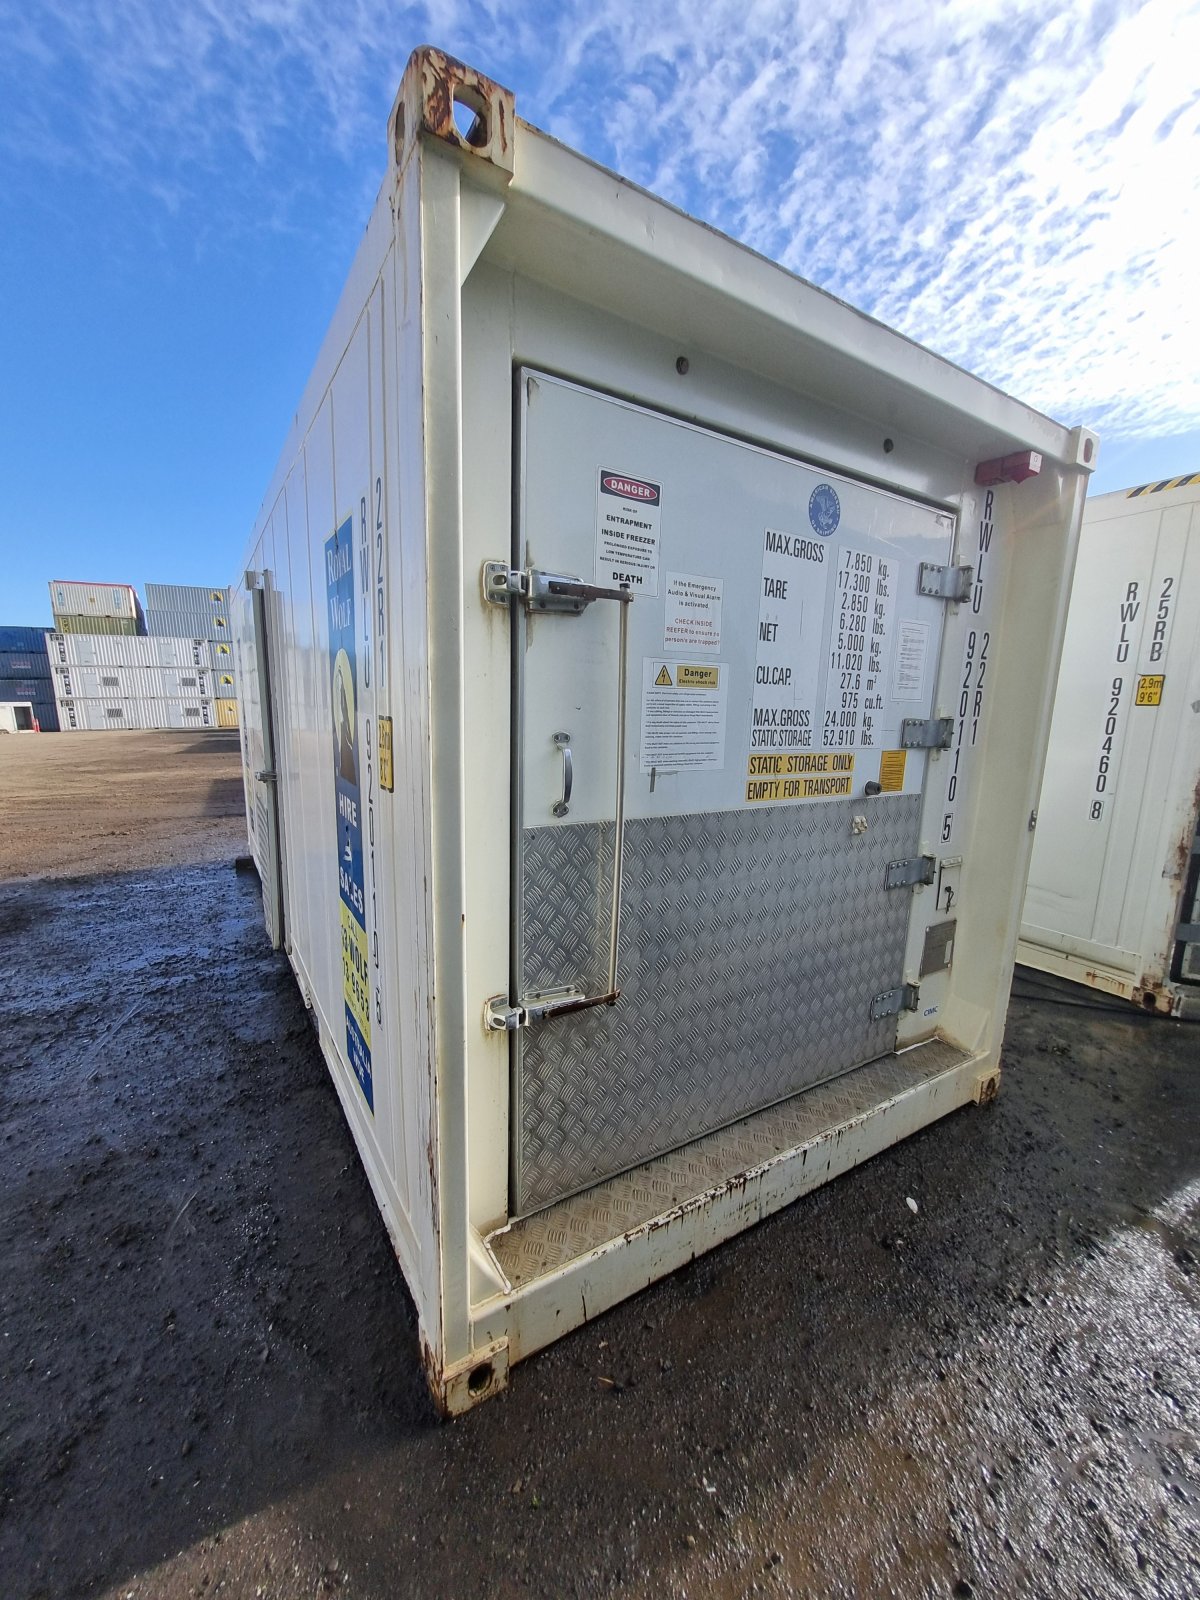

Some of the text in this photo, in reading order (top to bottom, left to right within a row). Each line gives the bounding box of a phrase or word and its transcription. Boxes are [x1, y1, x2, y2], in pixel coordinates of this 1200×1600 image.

[611, 479, 650, 498] DANGER
[606, 514, 652, 530] ENTRAPMENT
[601, 528, 656, 546] INSIDE FREEZER
[604, 541, 627, 549] PROLONGED
[627, 545, 647, 553] EXPOSURE
[765, 531, 825, 563] MAX.GROSS
[327, 543, 351, 586] ROYAL
[615, 550, 642, 560] TEMPERATURE
[612, 571, 643, 584] DEATH
[877, 558, 890, 579] kg.
[376, 477, 385, 687] 22R1
[687, 582, 716, 592] Emergency
[763, 577, 788, 600] TARE
[876, 578, 890, 598] lbs.
[359, 496, 370, 689] RWLU
[668, 589, 684, 597] Audio
[330, 595, 351, 632] WOLF
[874, 598, 886, 619] kg.
[872, 618, 886, 636] lbs.
[1150, 577, 1174, 662] 25RB
[666, 626, 689, 634] REEFER
[759, 622, 778, 643] NET
[870, 637, 882, 657] kg.
[684, 668, 712, 679] Danger
[868, 656, 882, 673] lbs.
[942, 489, 994, 840] RWLU 920110 5
[756, 665, 792, 686] CU.CAP.
[839, 672, 861, 691] 27.6
[972, 632, 990, 746] 22R1
[841, 692, 884, 710] 975 cu.ft.
[1091, 582, 1140, 819] RWLU 920460 8
[753, 708, 810, 727] MAX.GROSS
[862, 713, 874, 731] kg.
[752, 729, 812, 747] STATIC STORAGE
[860, 730, 874, 746] lbs.
[750, 754, 853, 775] STATIC STORAGE ONLY
[747, 777, 850, 800] EMPTY FOR TRANSPORT
[338, 791, 357, 828] HIRE
[351, 972, 370, 1022] 9653
[923, 1005, 938, 1017] CIMC
